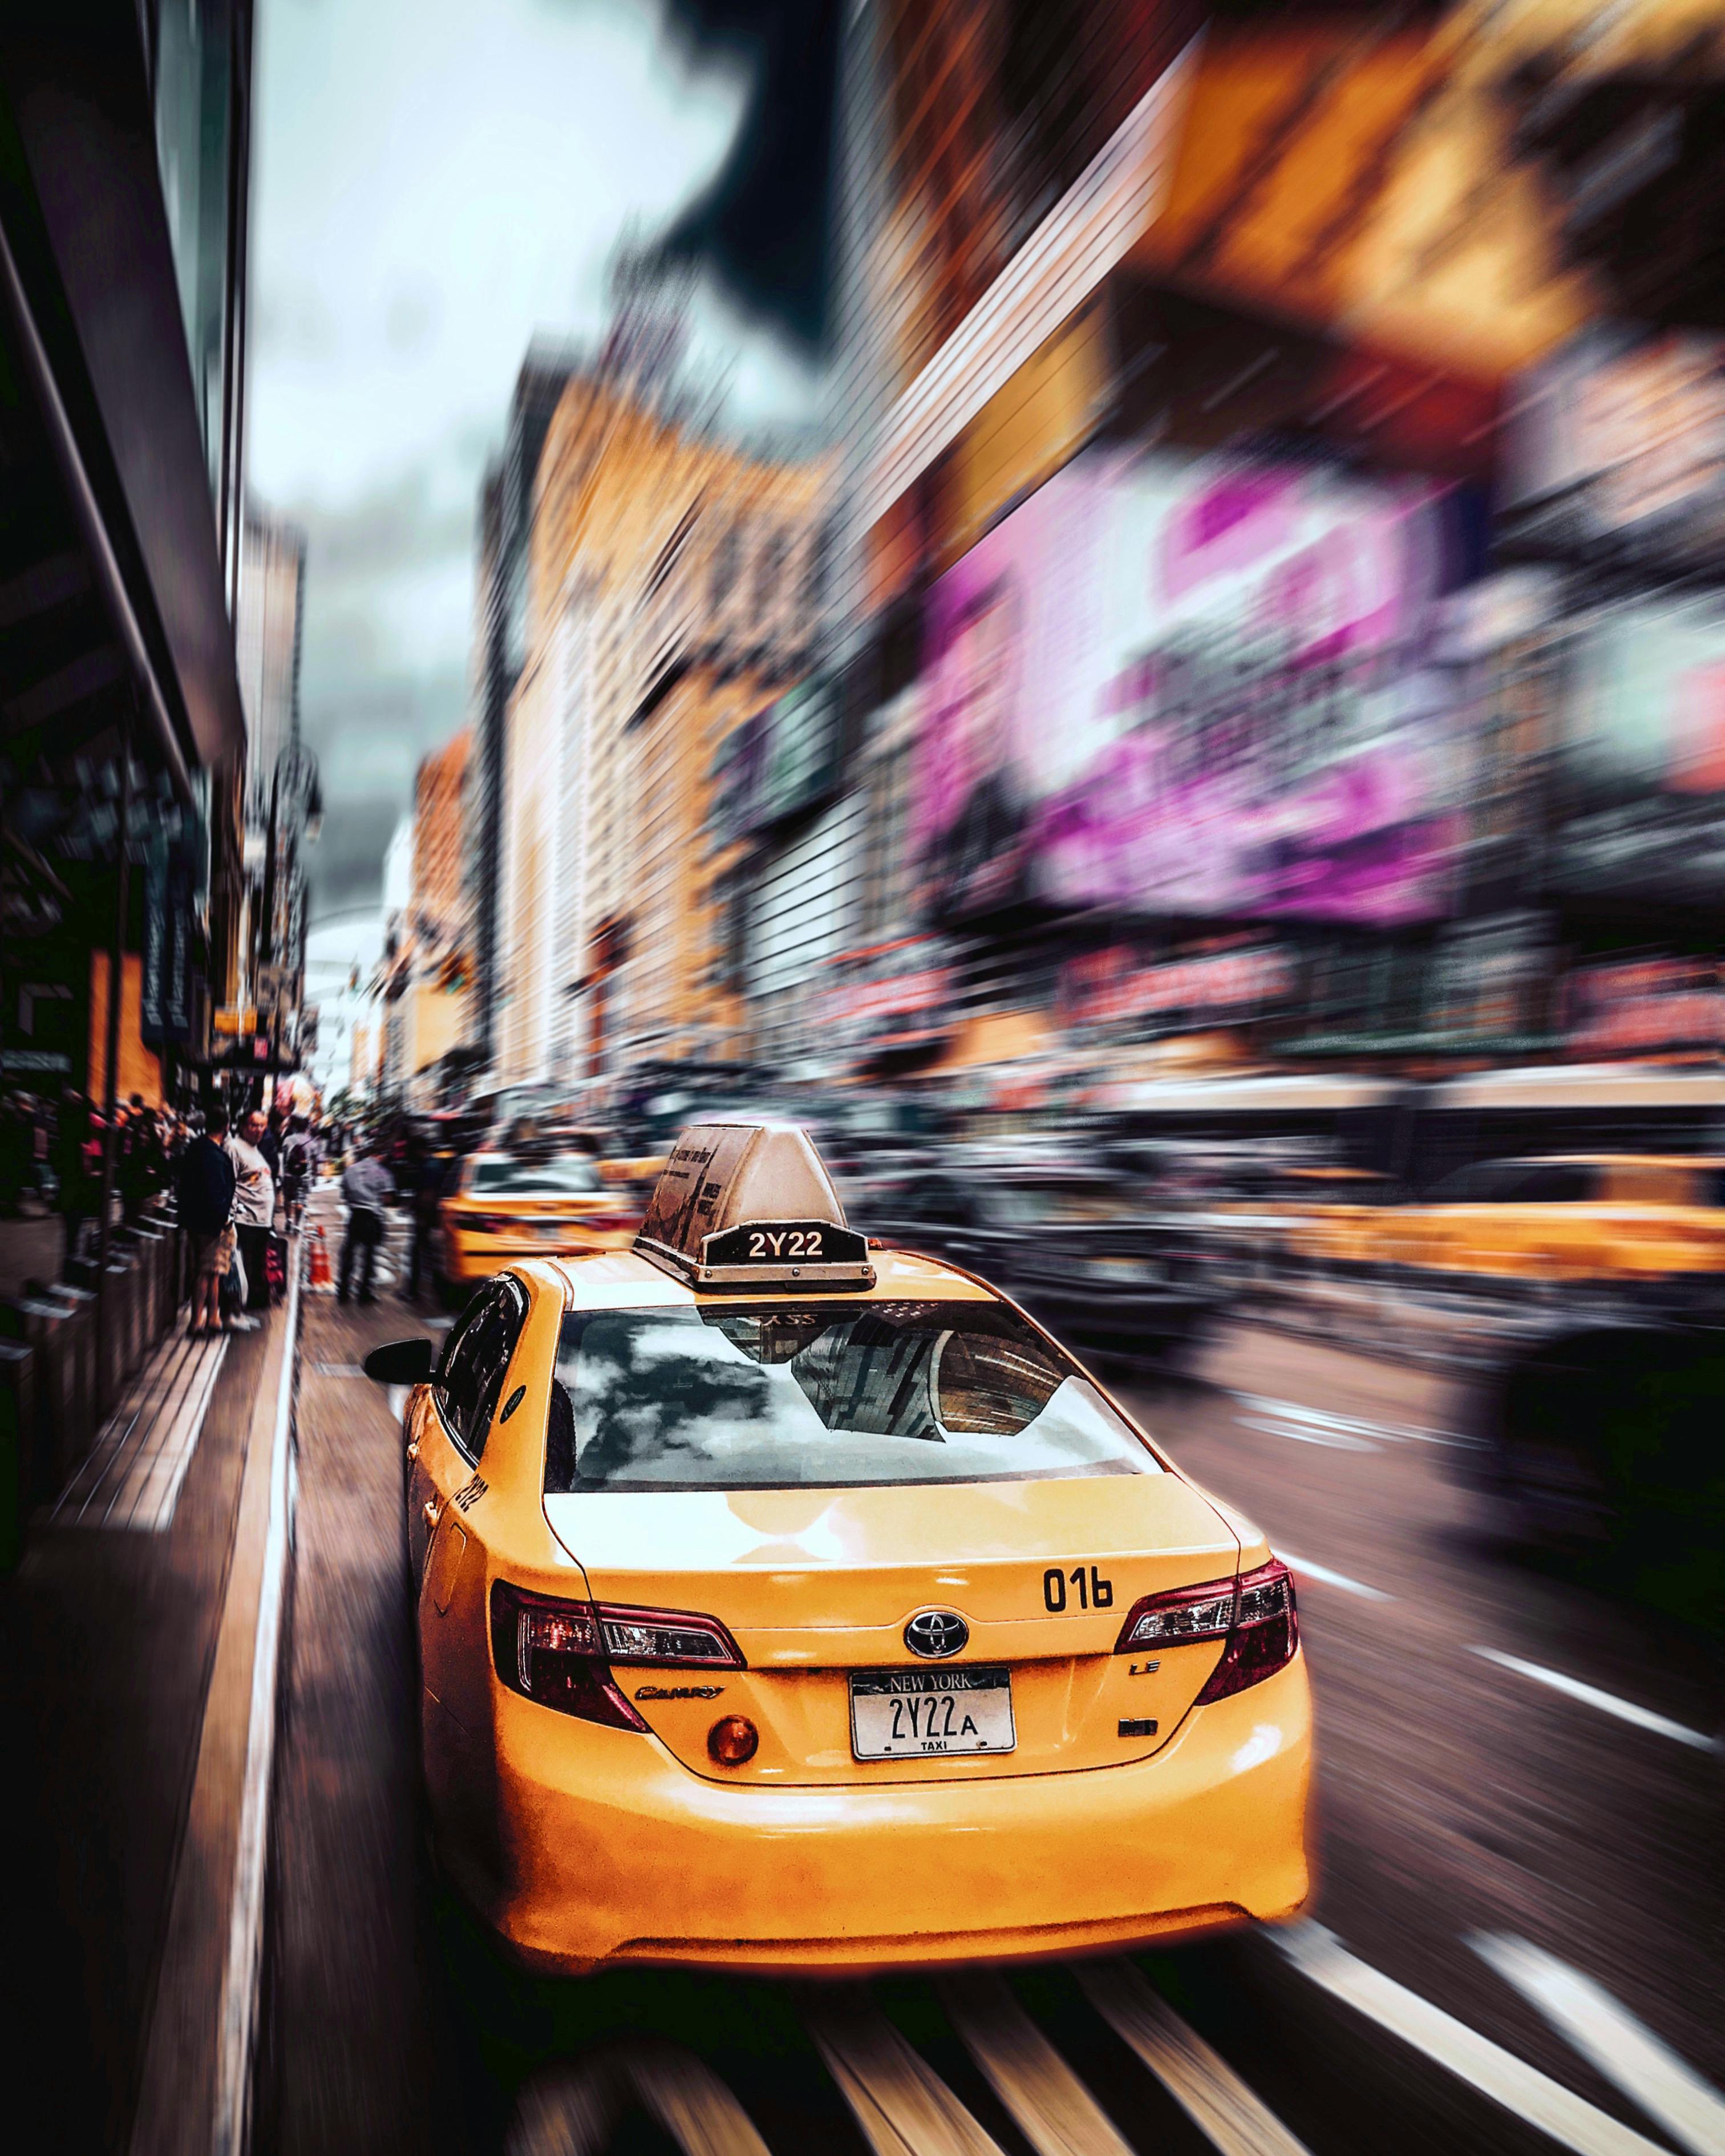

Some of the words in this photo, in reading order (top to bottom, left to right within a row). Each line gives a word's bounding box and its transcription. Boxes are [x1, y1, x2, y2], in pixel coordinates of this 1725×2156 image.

[748, 1231, 823, 1257] 2Y22
[1129, 1659, 1161, 1676] LE
[890, 1675, 925, 1693] NEW
[930, 1673, 973, 1690] YORK
[921, 1740, 947, 1751] TAXI
